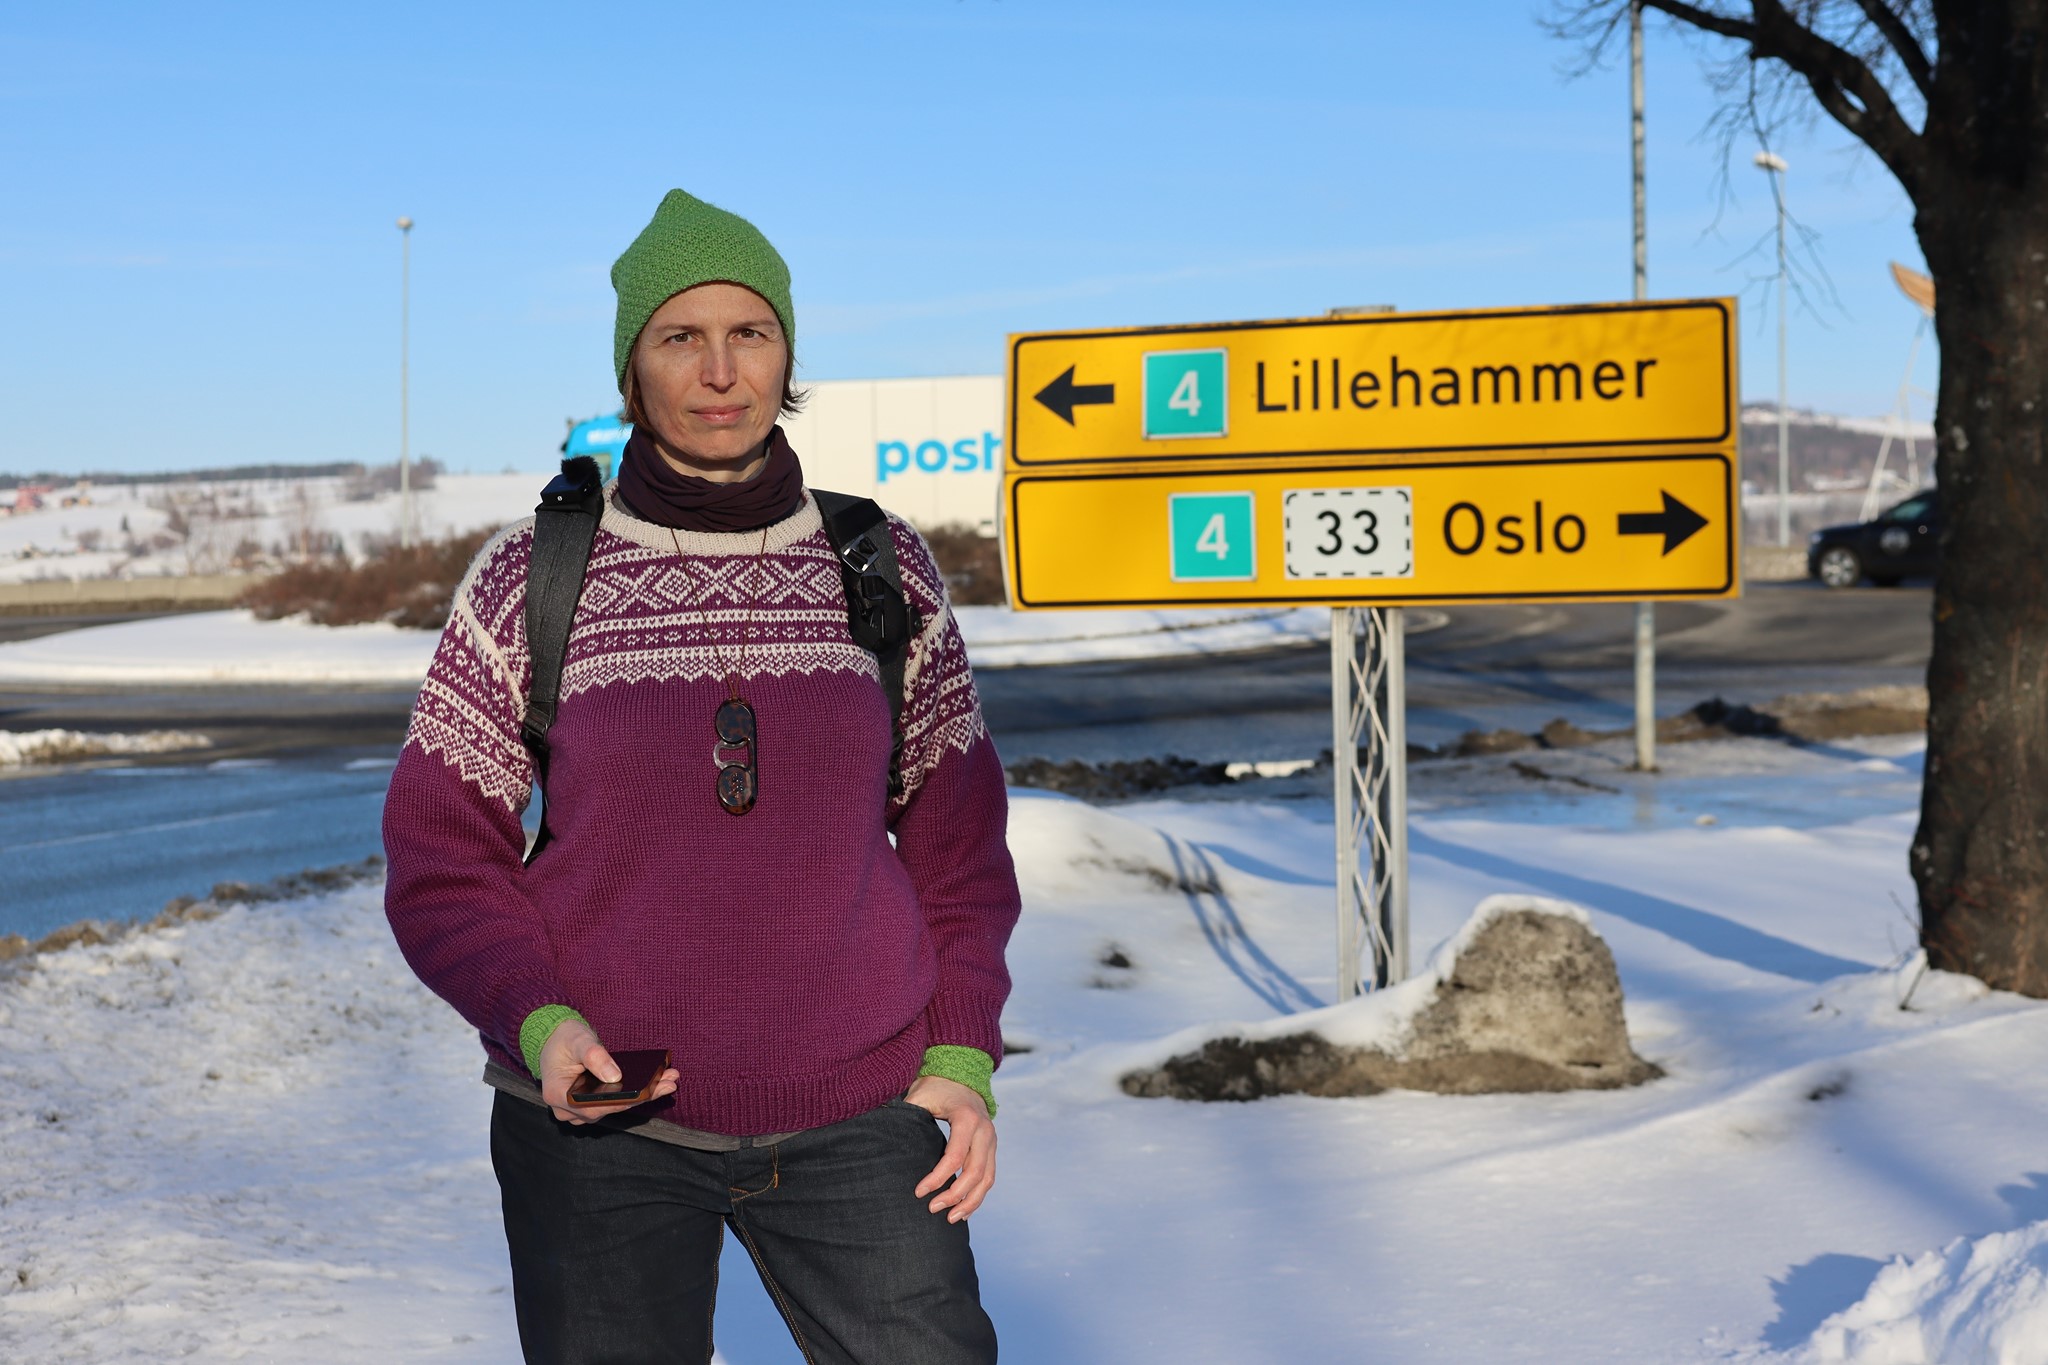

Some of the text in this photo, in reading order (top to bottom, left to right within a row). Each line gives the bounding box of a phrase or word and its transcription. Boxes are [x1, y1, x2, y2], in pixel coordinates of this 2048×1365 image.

[1168, 356, 1658, 416] 4 Lillehammer
[1195, 500, 1586, 560] 4 33 Oslo
